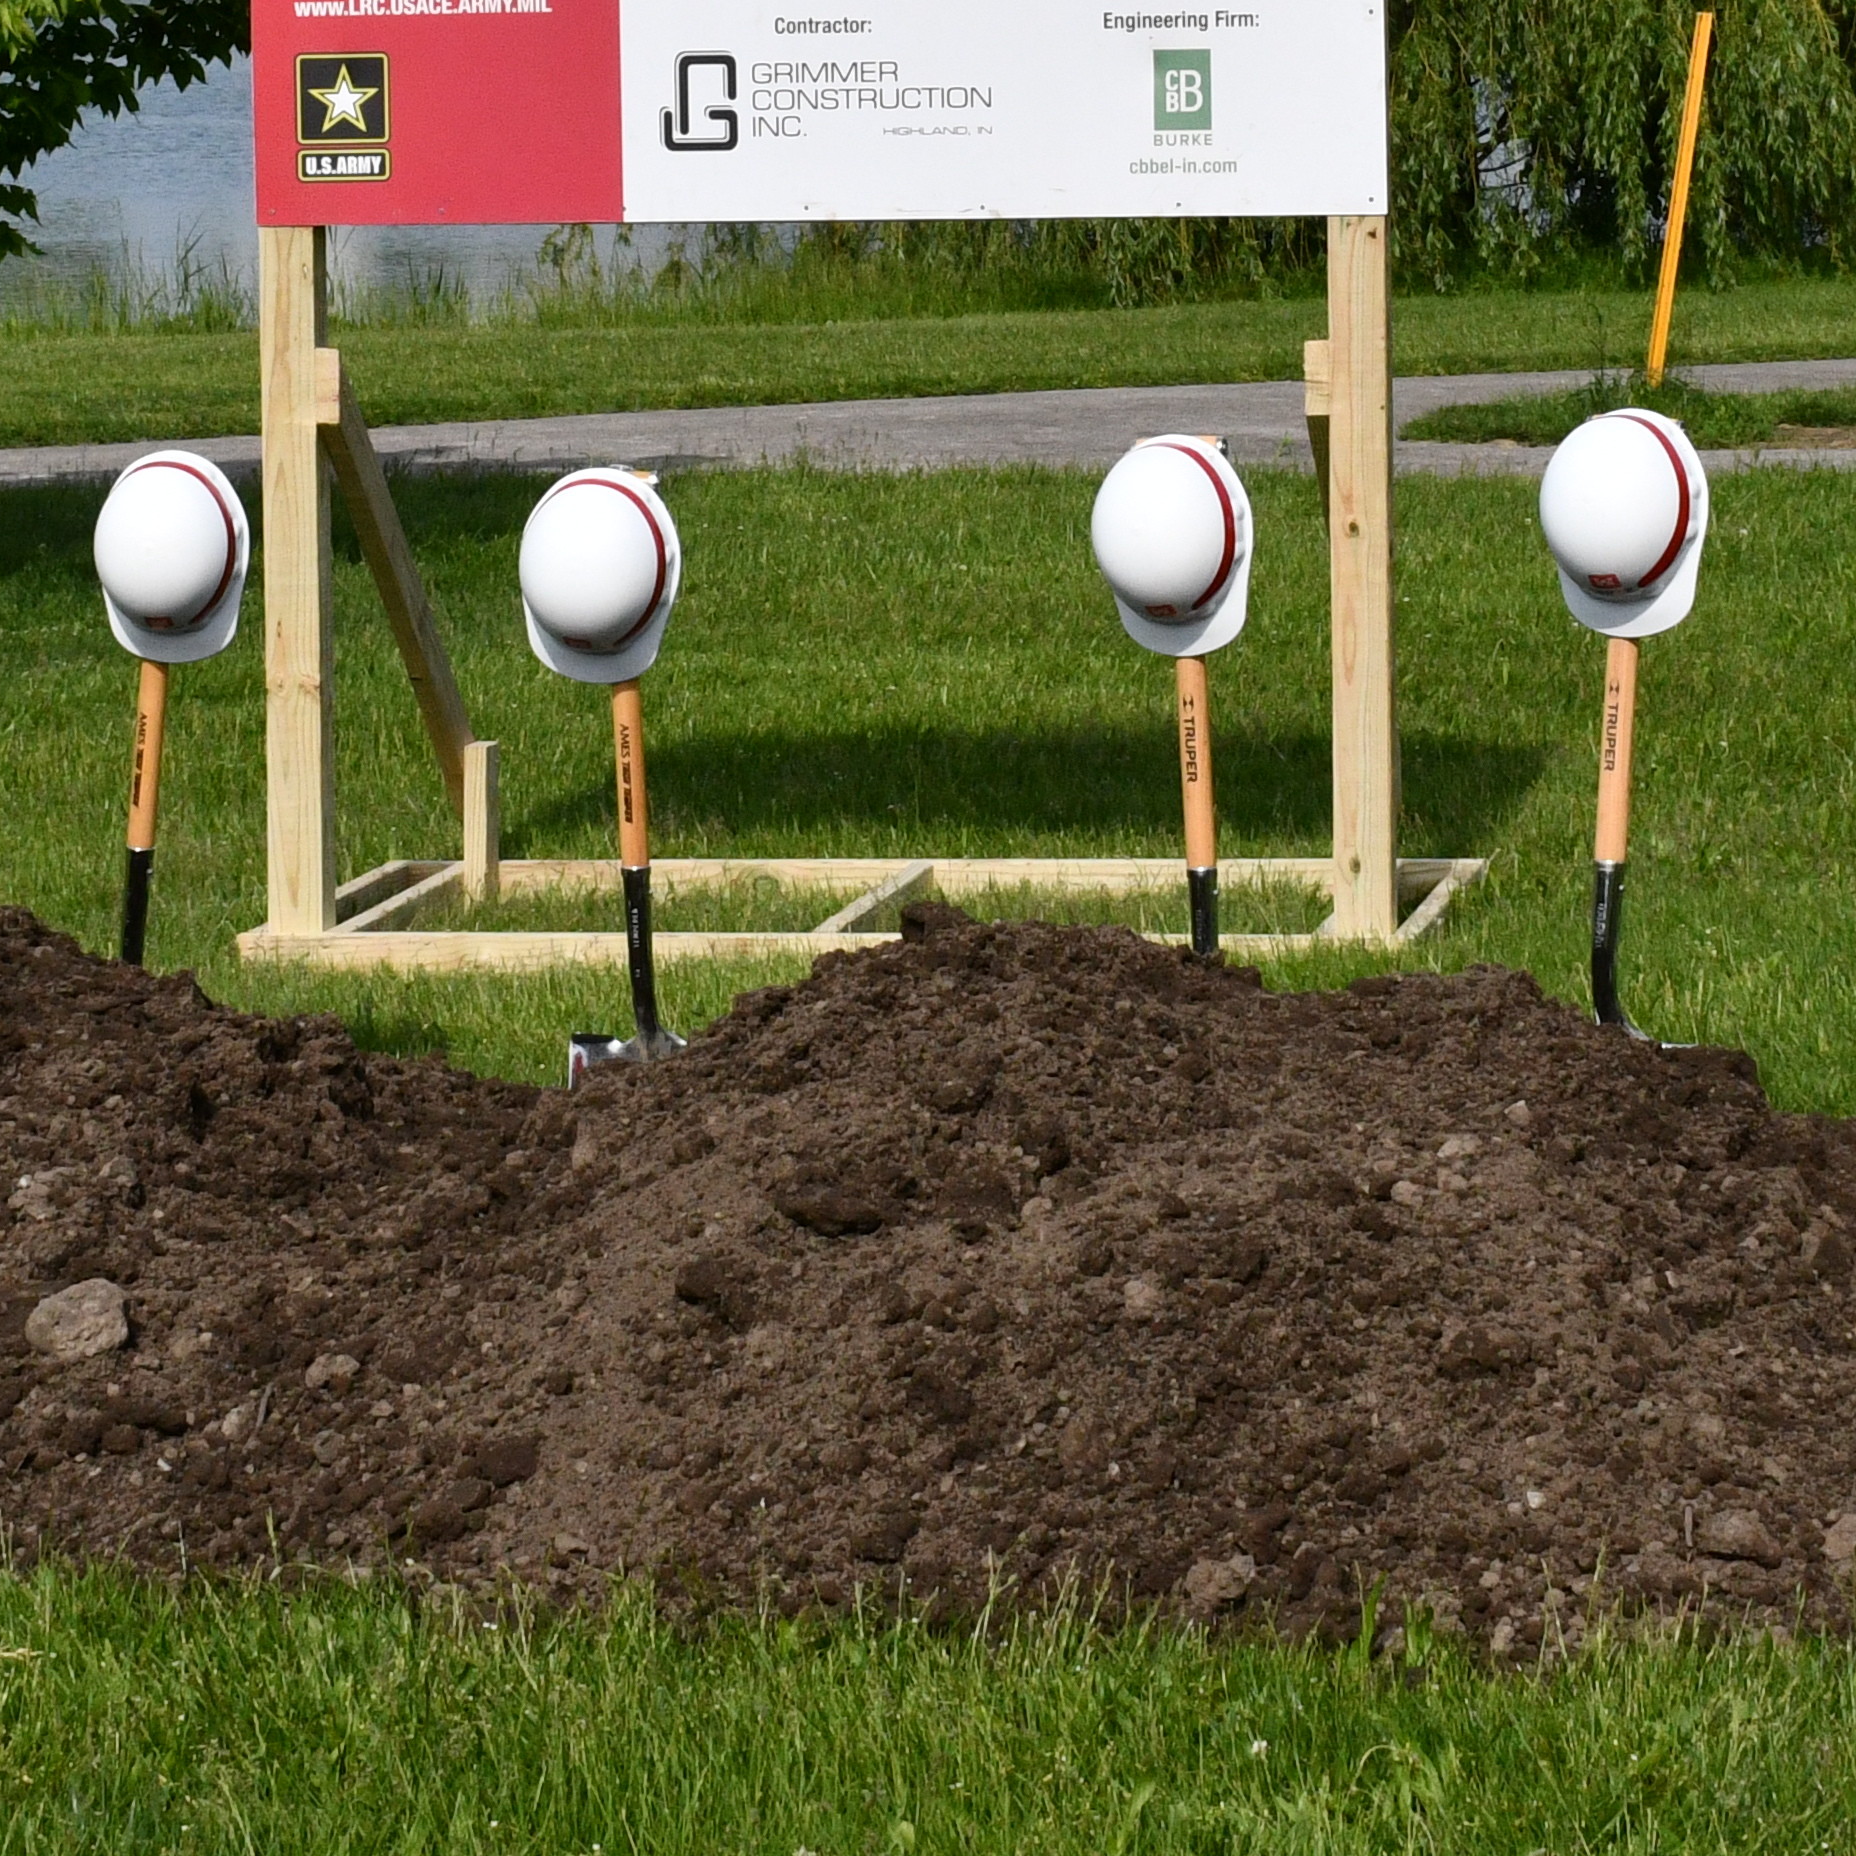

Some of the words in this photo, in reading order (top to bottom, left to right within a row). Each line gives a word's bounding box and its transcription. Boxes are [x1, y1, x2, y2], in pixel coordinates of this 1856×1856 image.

[774, 16, 873, 36] Contractor:
[1103, 11, 1209, 33] Engineering
[1215, 10, 1260, 28] Firm:
[751, 61, 899, 84] GRIMMER
[751, 86, 993, 110] CONSTRUCTION
[751, 115, 808, 138] INC.
[883, 126, 971, 136] HIGHLAND,
[978, 126, 993, 135] IN
[1153, 134, 1213, 147] BURKE
[1129, 158, 1238, 174] cbbel-in.com
[137, 712, 148, 745] AMES
[1603, 703, 1619, 771] TRUPER
[619, 723, 631, 758] AMES
[1182, 716, 1198, 783] TRUPER
